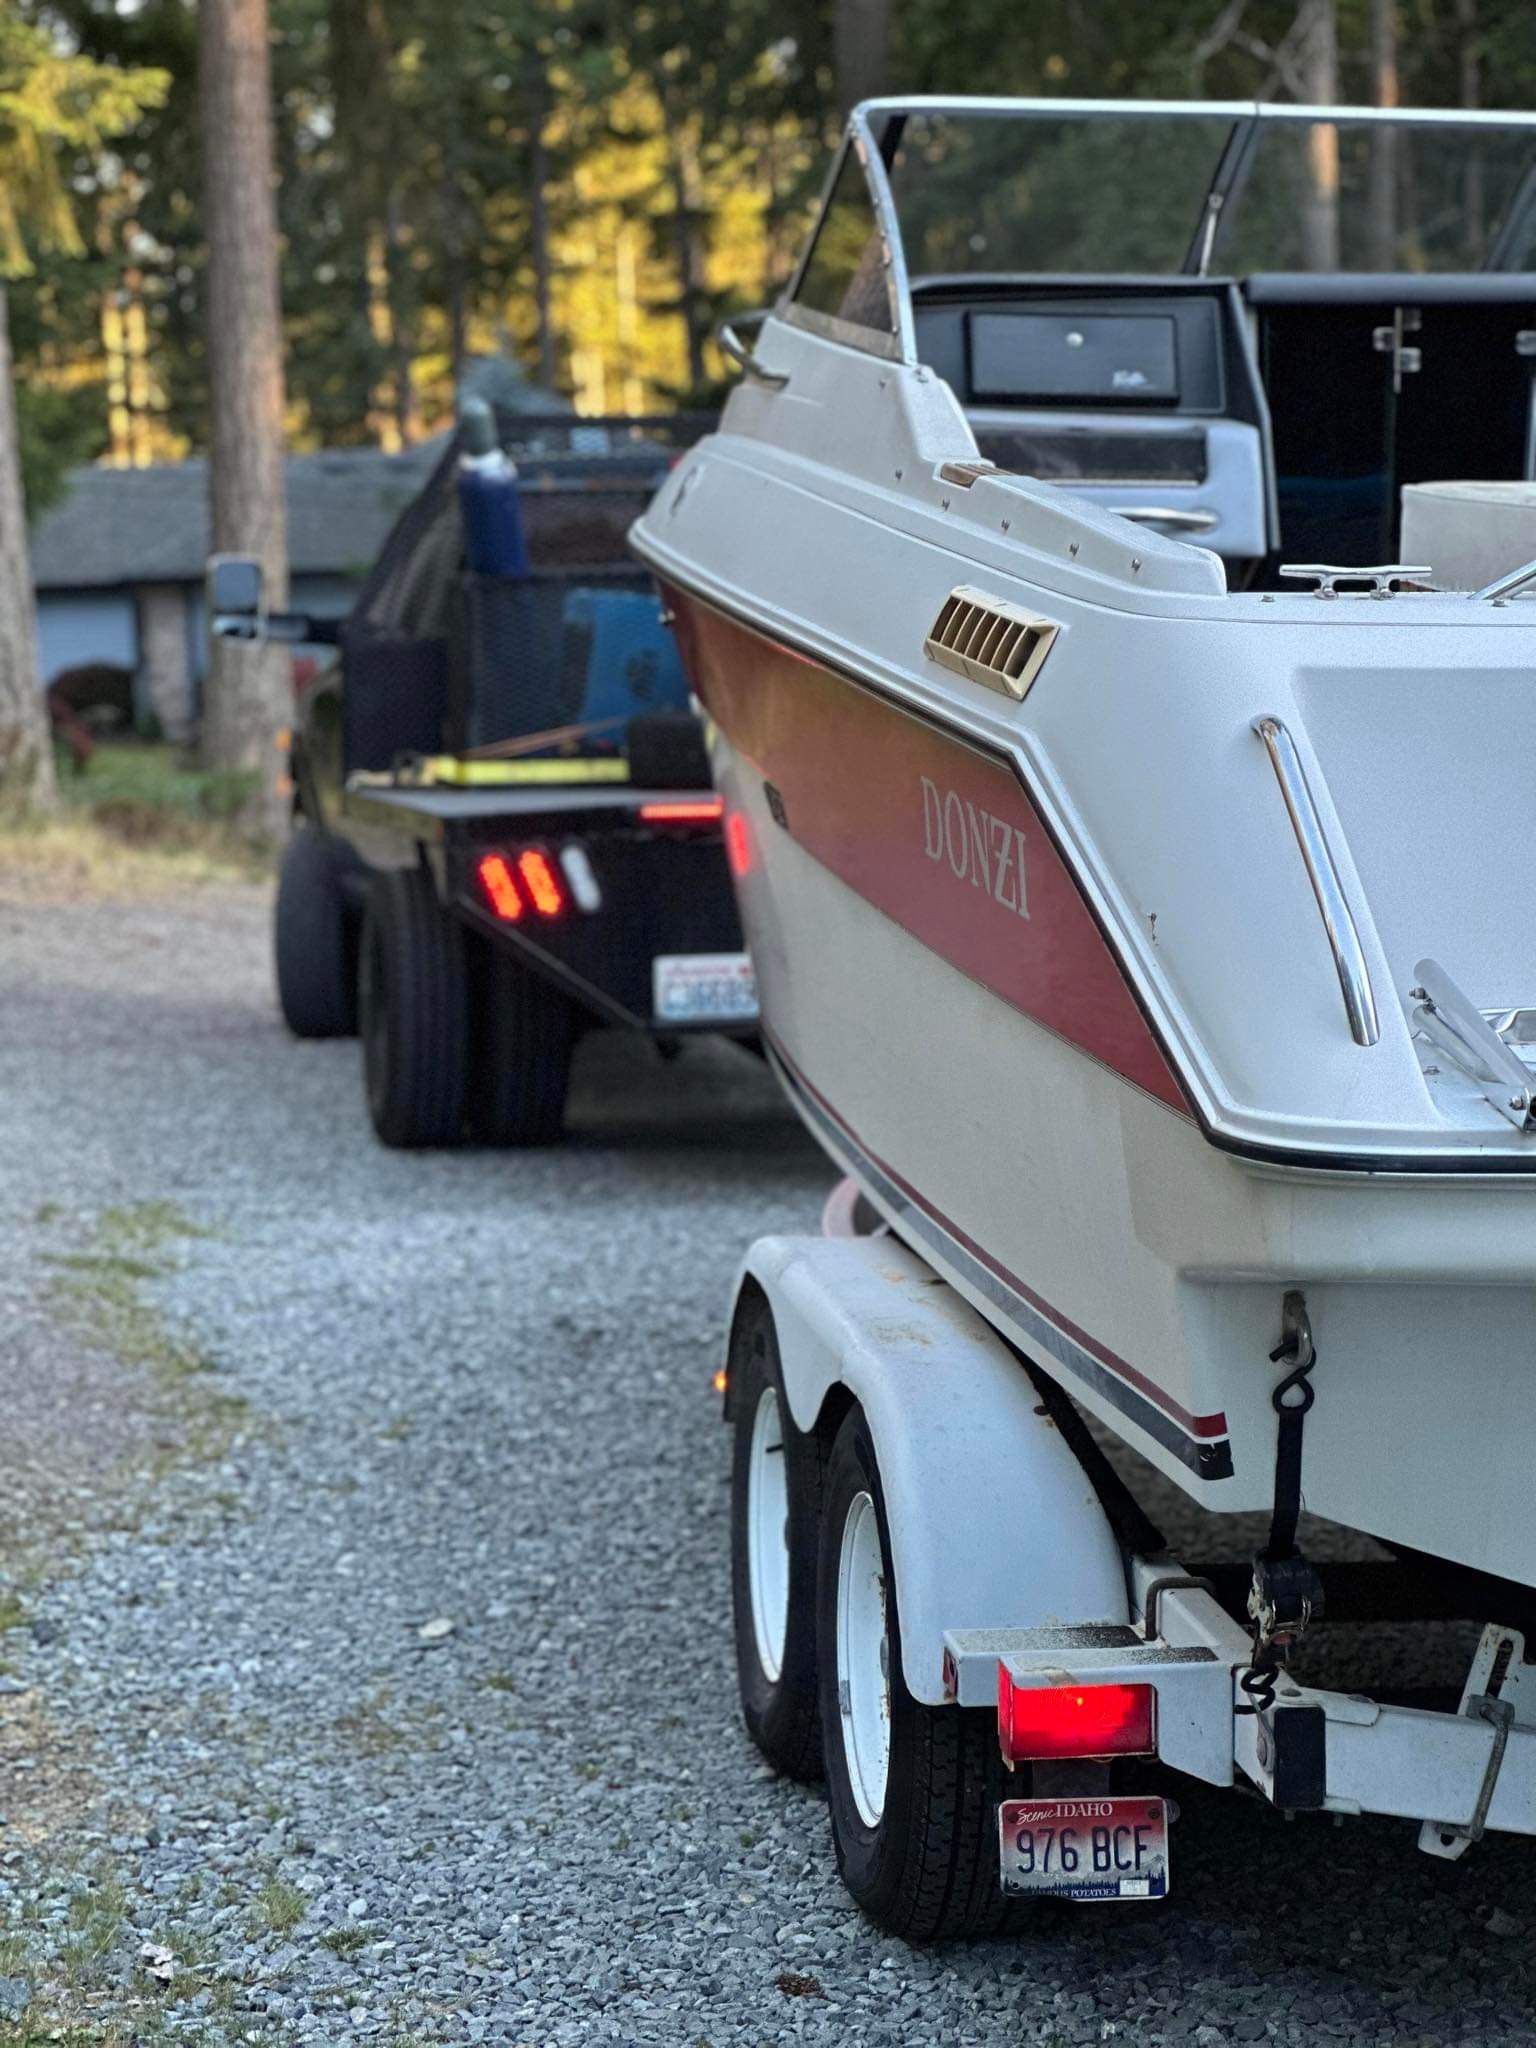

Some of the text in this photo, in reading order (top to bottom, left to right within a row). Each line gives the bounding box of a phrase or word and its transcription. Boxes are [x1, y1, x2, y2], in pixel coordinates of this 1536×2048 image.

[920, 775, 1030, 921] DONZI
[1016, 1802, 1113, 1825] Scenic IDAHO
[1016, 1824, 1152, 1874] 976 BCF
[1070, 1888, 1117, 1897] POTATOES
